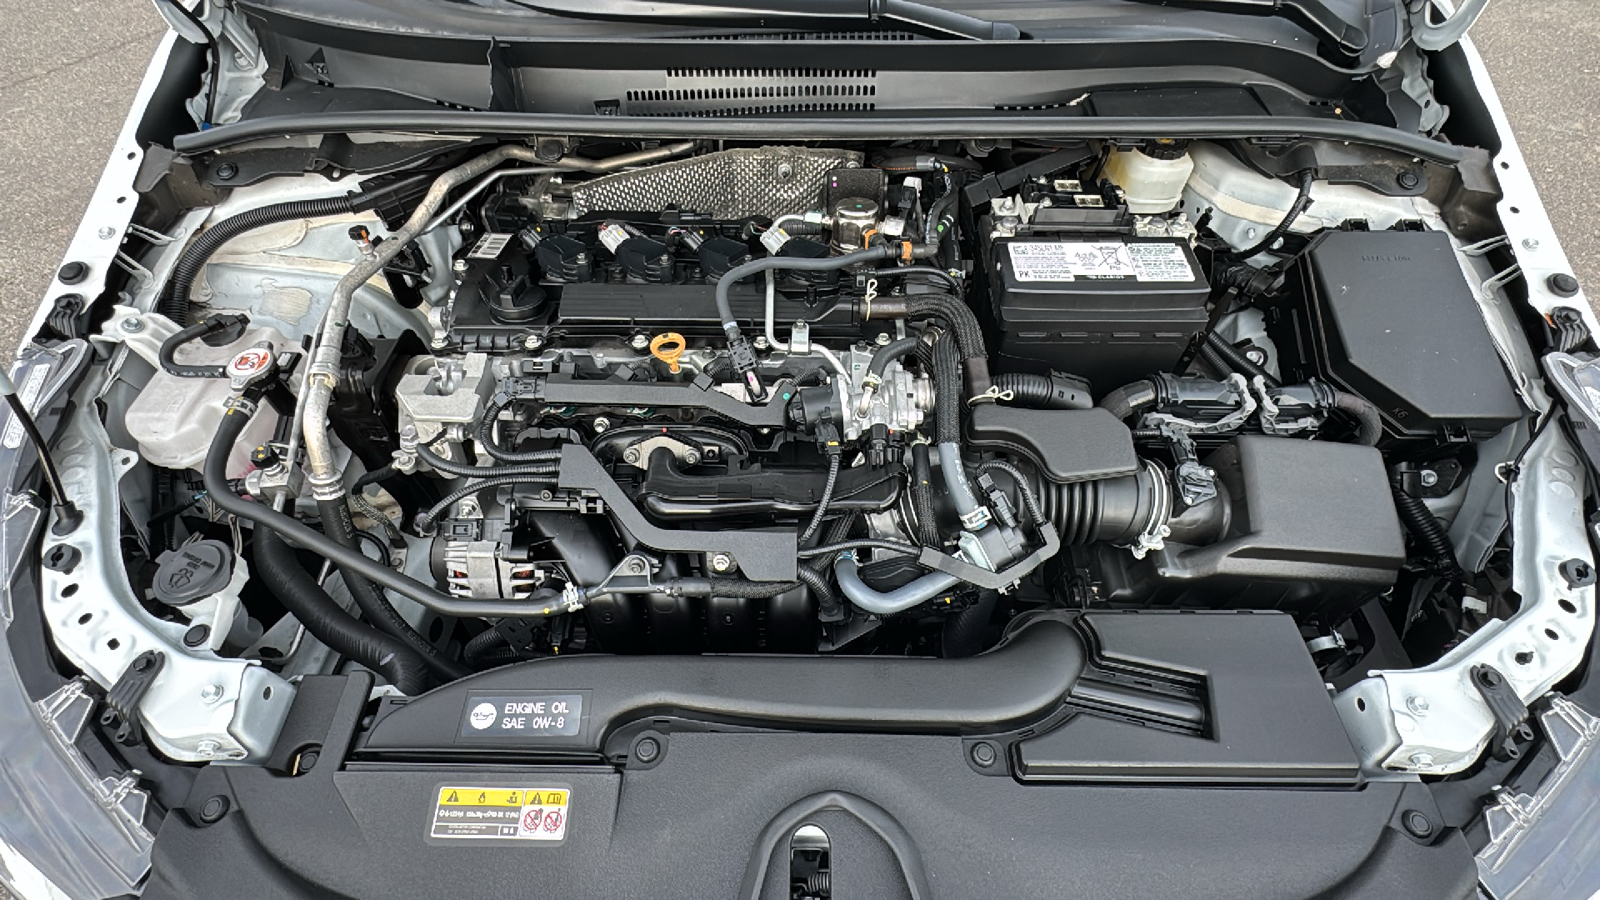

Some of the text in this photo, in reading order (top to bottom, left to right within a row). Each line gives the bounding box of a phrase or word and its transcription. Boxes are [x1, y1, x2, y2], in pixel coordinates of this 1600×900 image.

[1018, 270, 1030, 278] PK
[504, 702, 570, 714] ENGINE OIL
[501, 716, 565, 729] SAE 0W-8
